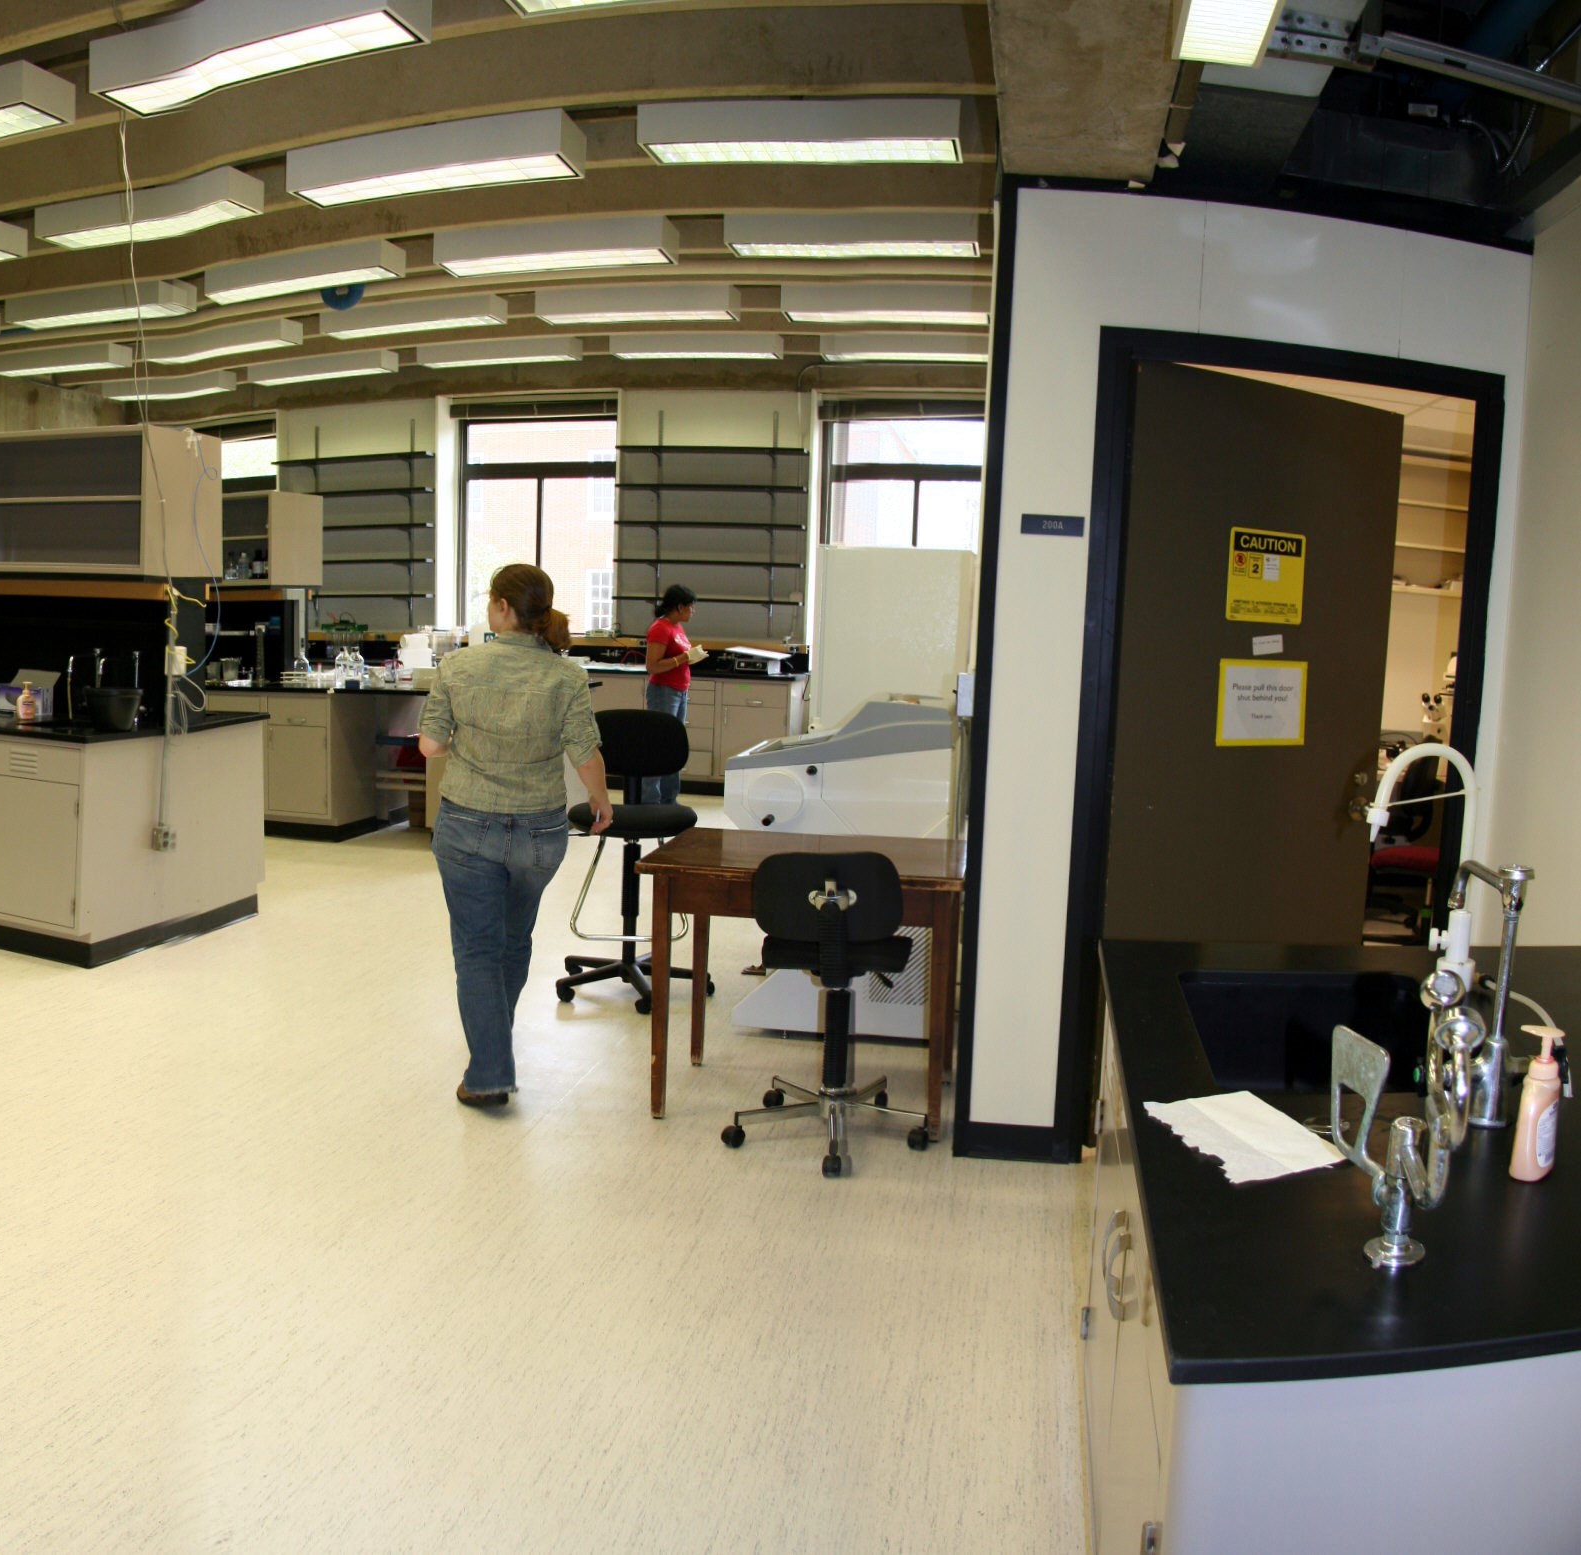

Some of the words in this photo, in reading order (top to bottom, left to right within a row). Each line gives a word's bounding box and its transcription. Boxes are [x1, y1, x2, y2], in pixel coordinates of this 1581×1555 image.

[1042, 520, 1064, 530] 200A
[1240, 535, 1297, 553] CAUTION
[1252, 563, 1259, 574] 2
[1232, 683, 1252, 691] Please
[1253, 684, 1265, 692] pull
[1252, 694, 1273, 702] behind
